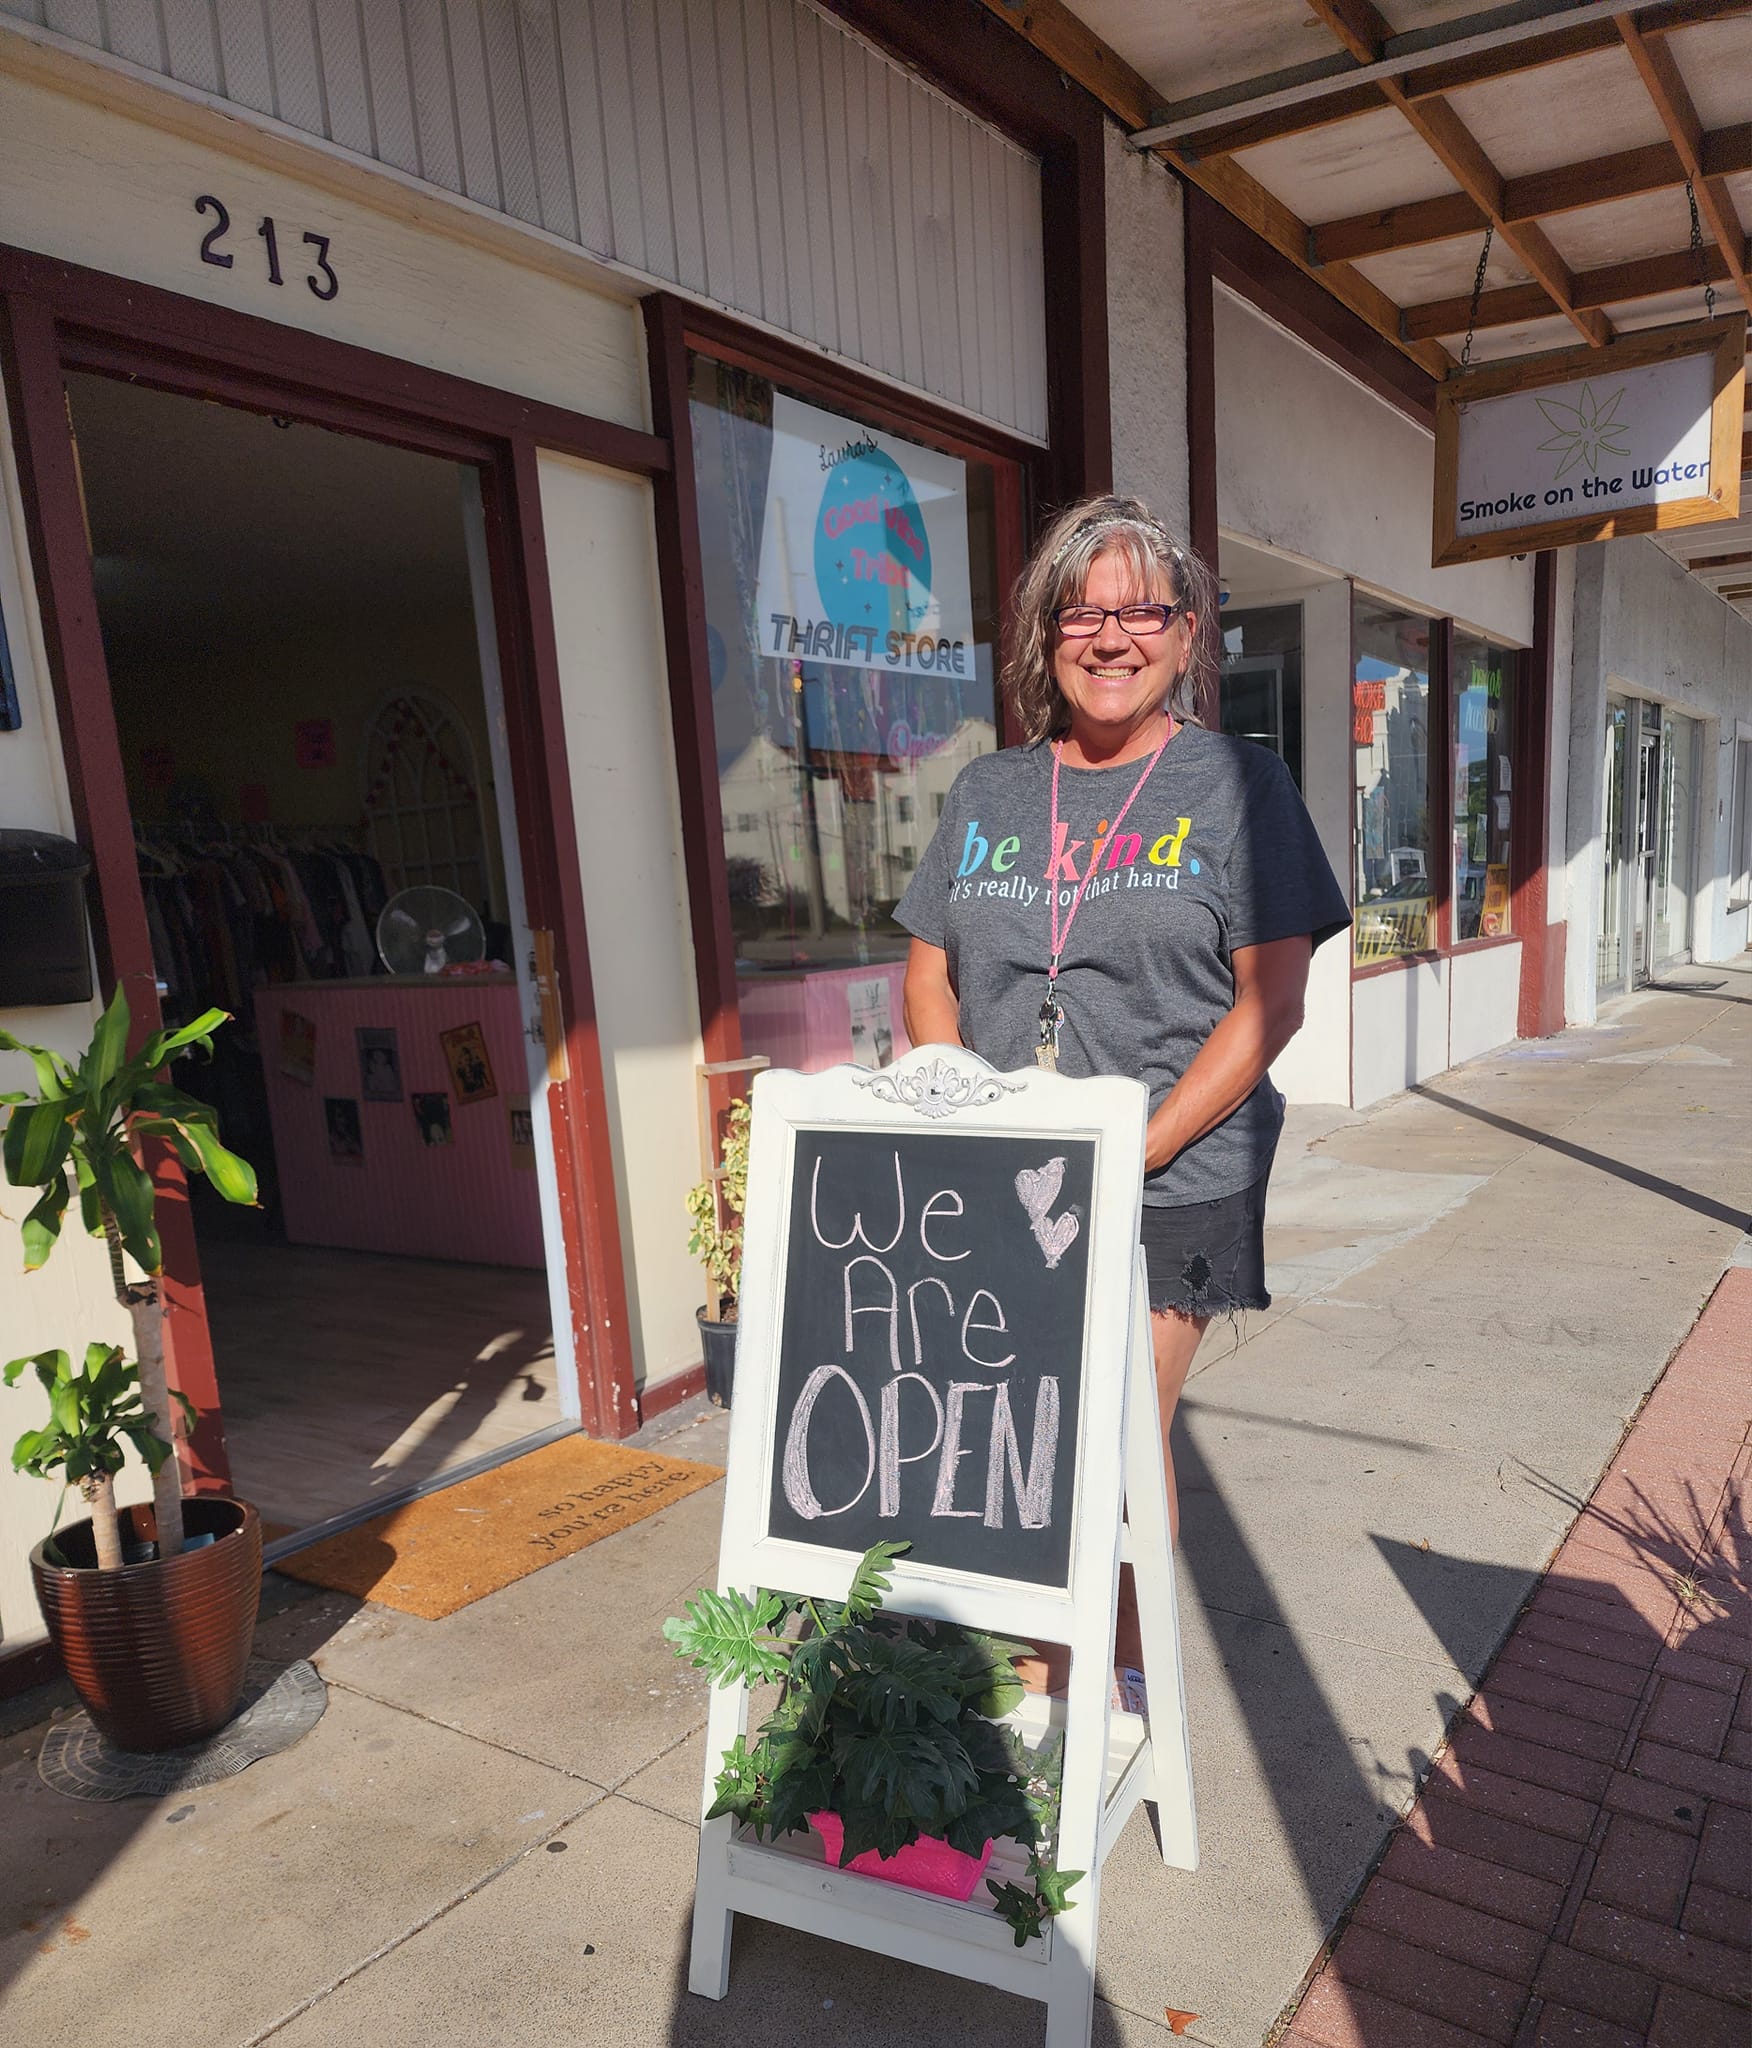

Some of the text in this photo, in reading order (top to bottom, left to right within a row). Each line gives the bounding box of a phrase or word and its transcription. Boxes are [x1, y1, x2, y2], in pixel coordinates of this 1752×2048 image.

[194, 194, 339, 301] 213
[819, 429, 879, 471] Laura's
[823, 494, 880, 539] Good
[1460, 492, 1536, 521] Smoke
[1544, 487, 1574, 506] on
[1582, 477, 1623, 498] the
[1632, 461, 1710, 489] Water
[851, 548, 911, 589] Tribe
[770, 613, 966, 674] THRIFT STORE
[957, 817, 1200, 881] be kind.
[949, 879, 973, 904] it's
[977, 875, 1040, 907] really
[1085, 871, 1120, 901] that
[1127, 867, 1179, 890] hard
[811, 1151, 971, 1261] We
[844, 1255, 1016, 1370] Are
[783, 1364, 1060, 1529] OPEN
[538, 1460, 666, 1520] so happy
[527, 1500, 626, 1551] you're
